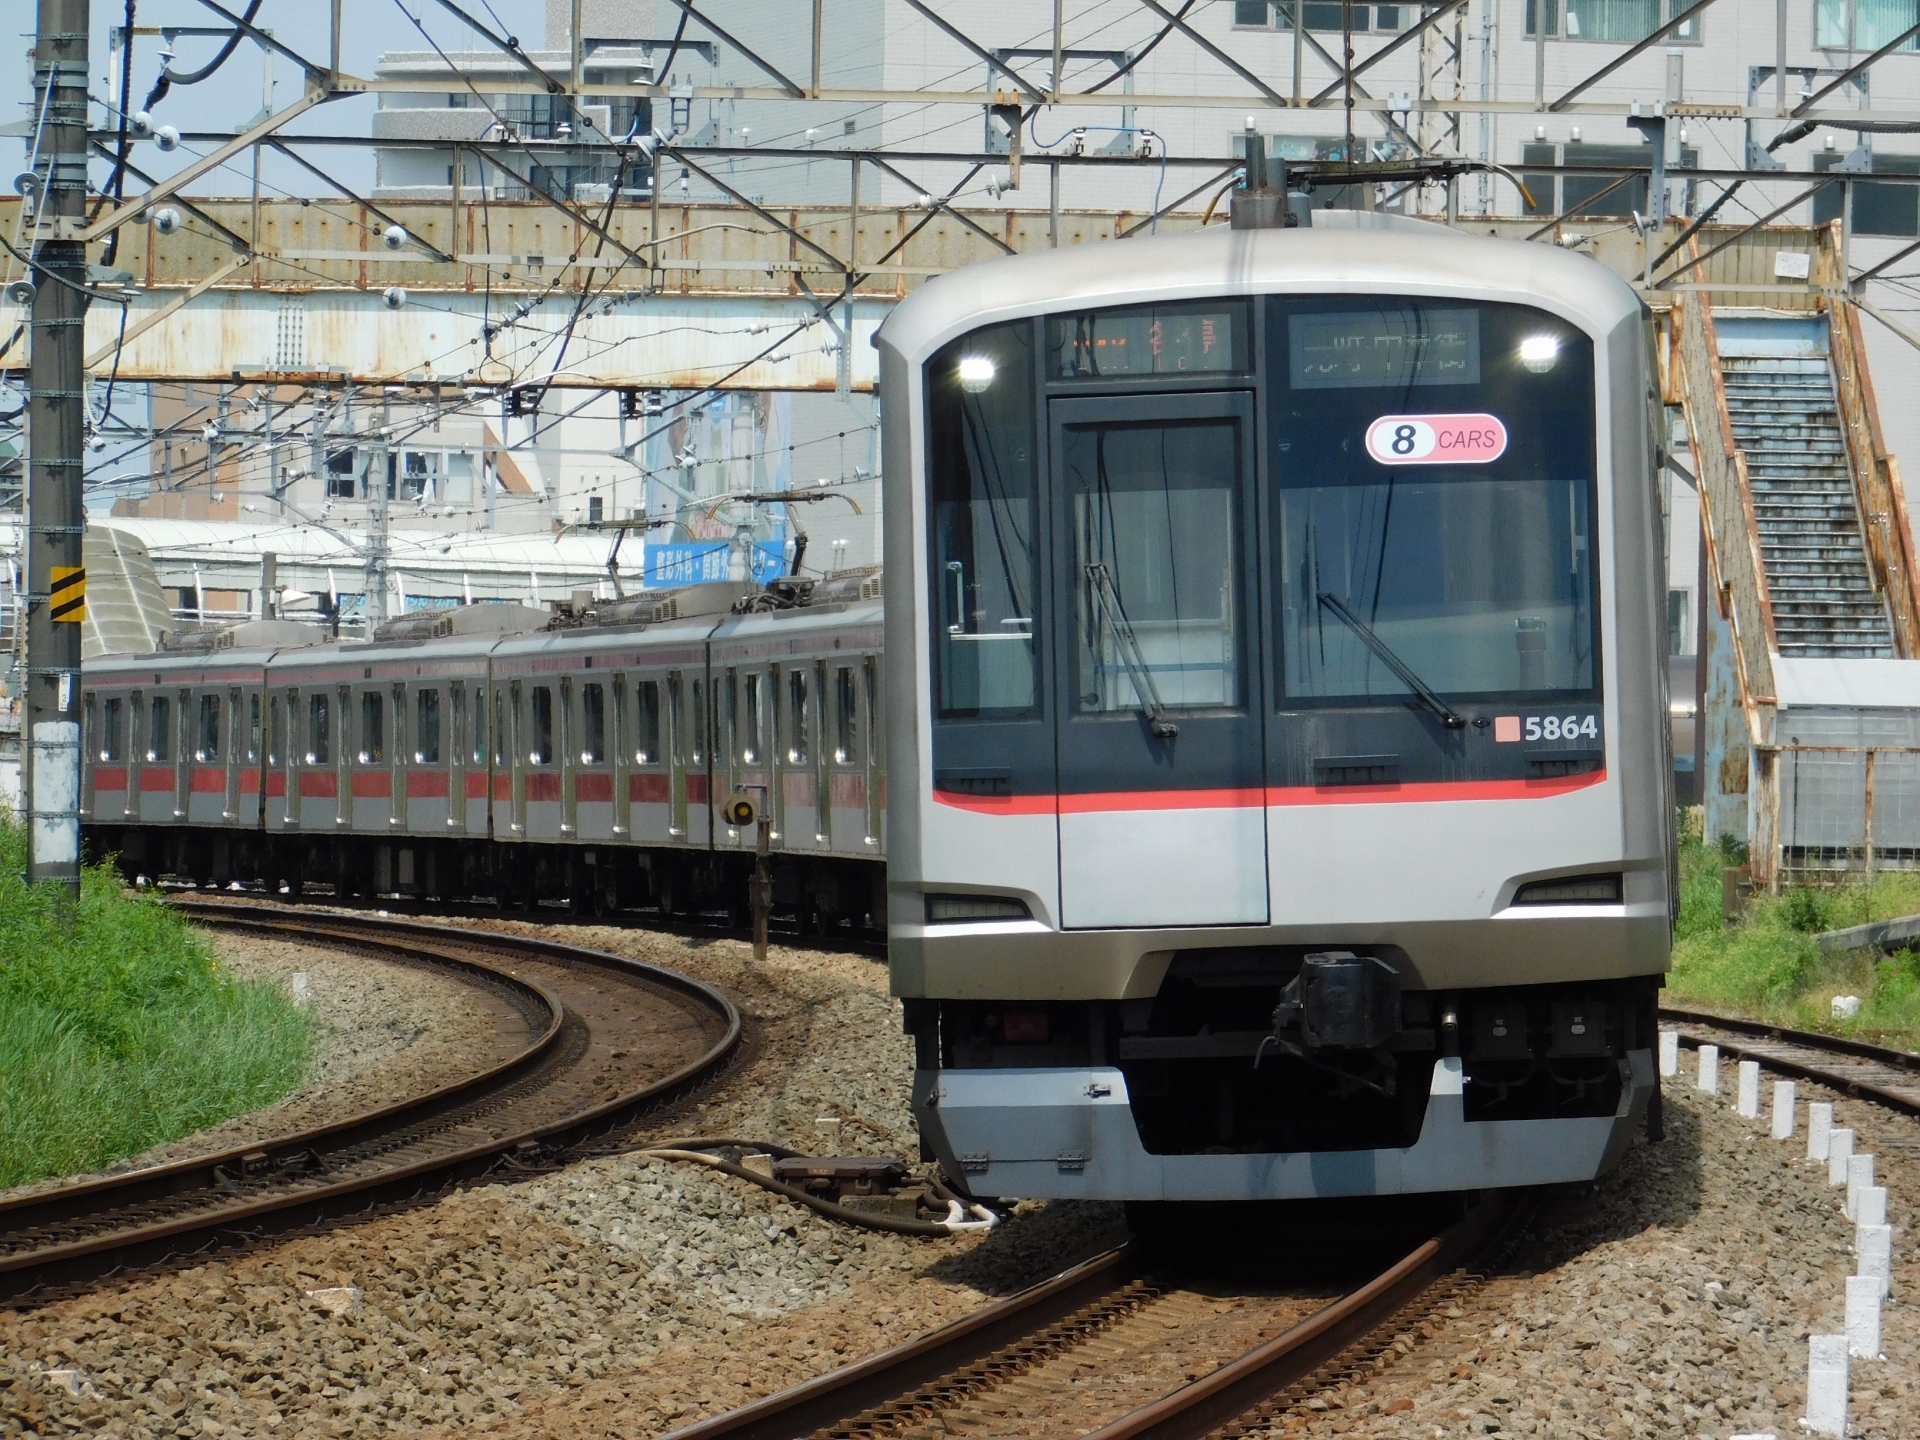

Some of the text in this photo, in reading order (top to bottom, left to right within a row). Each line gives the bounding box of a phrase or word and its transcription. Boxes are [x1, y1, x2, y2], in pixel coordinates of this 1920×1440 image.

[1391, 424, 1496, 455] 8 CARS
[1525, 715, 1598, 741] 5864
